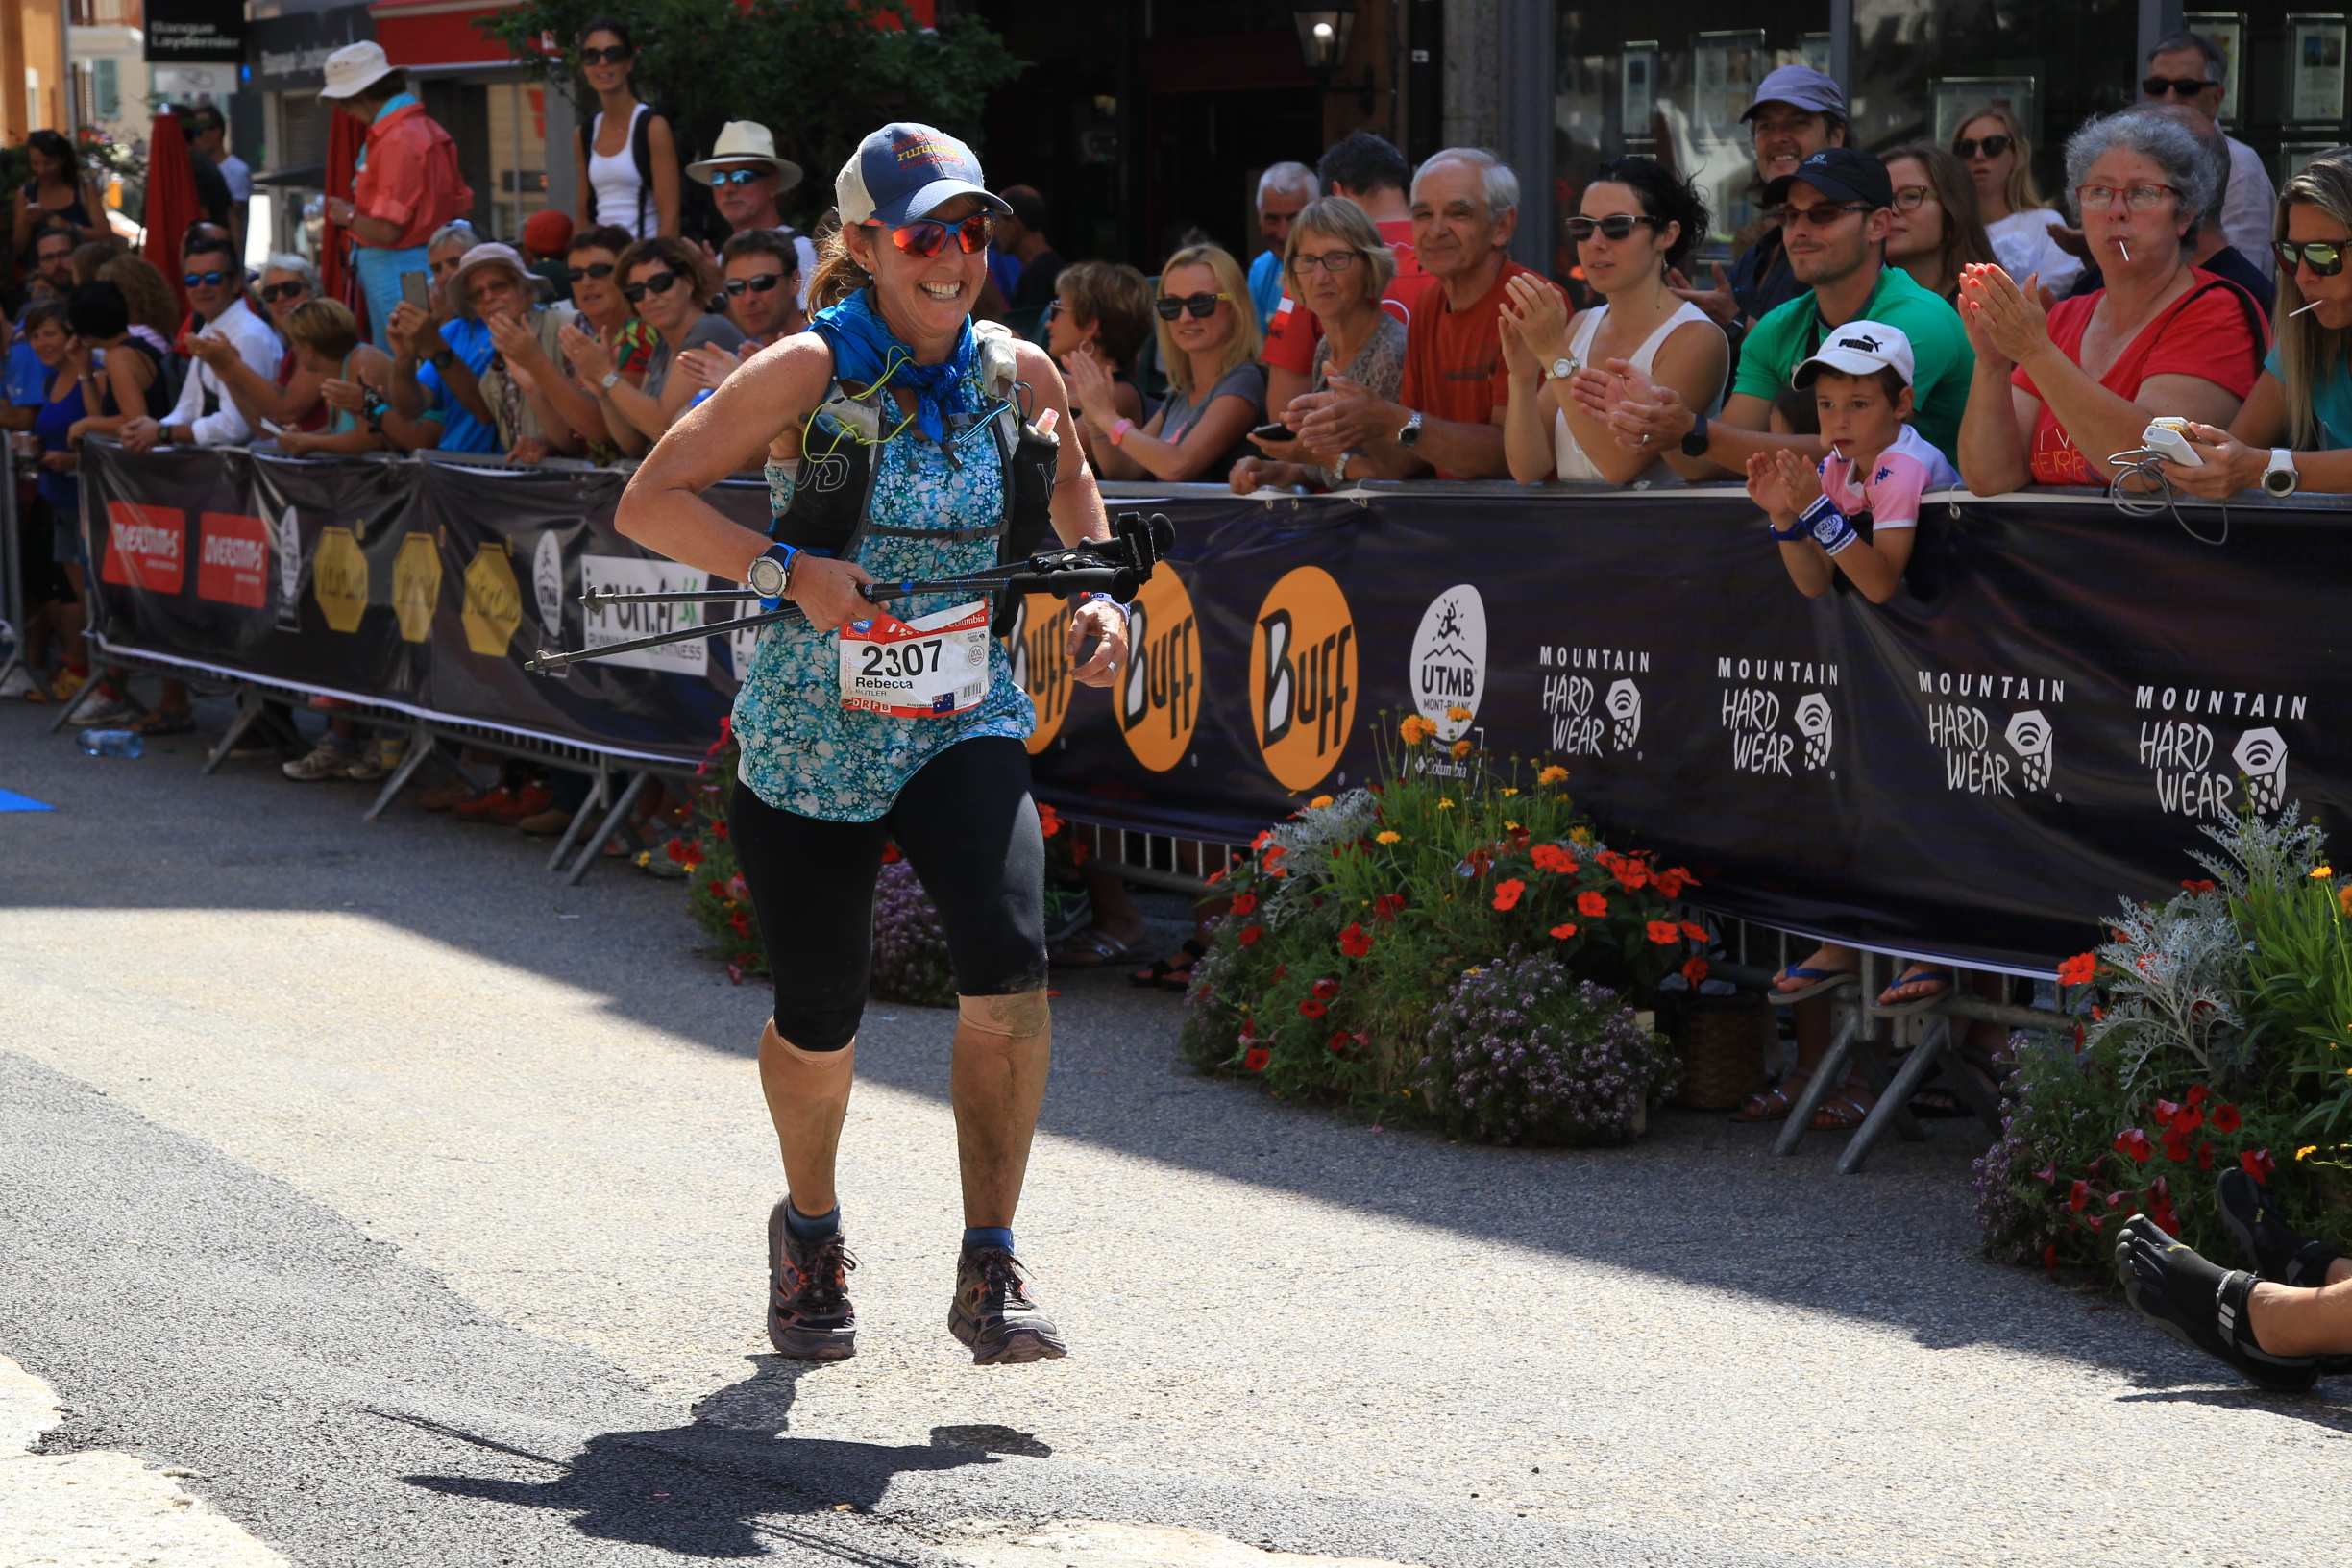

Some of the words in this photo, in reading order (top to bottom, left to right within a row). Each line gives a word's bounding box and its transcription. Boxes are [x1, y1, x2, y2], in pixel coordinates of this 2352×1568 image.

[861, 639, 943, 677] 2307
[1539, 645, 1651, 673] MOUNTAIN
[1717, 656, 1839, 686] MOUNTAIN
[855, 677, 913, 690] Rebecca
[1422, 664, 1475, 698] UTMB
[1543, 674, 1595, 717] HARD
[1918, 671, 2065, 703] MOUNTAIN
[1722, 686, 1780, 733] HARD
[2135, 685, 2308, 721] MOUNTAIN
[1552, 714, 1605, 759] WEAR
[1928, 702, 1989, 752] HARD
[2139, 720, 2215, 772] HARD
[1732, 728, 1795, 778] WEAR
[1946, 747, 2016, 799] WEAR
[2156, 766, 2234, 819] WEAR
